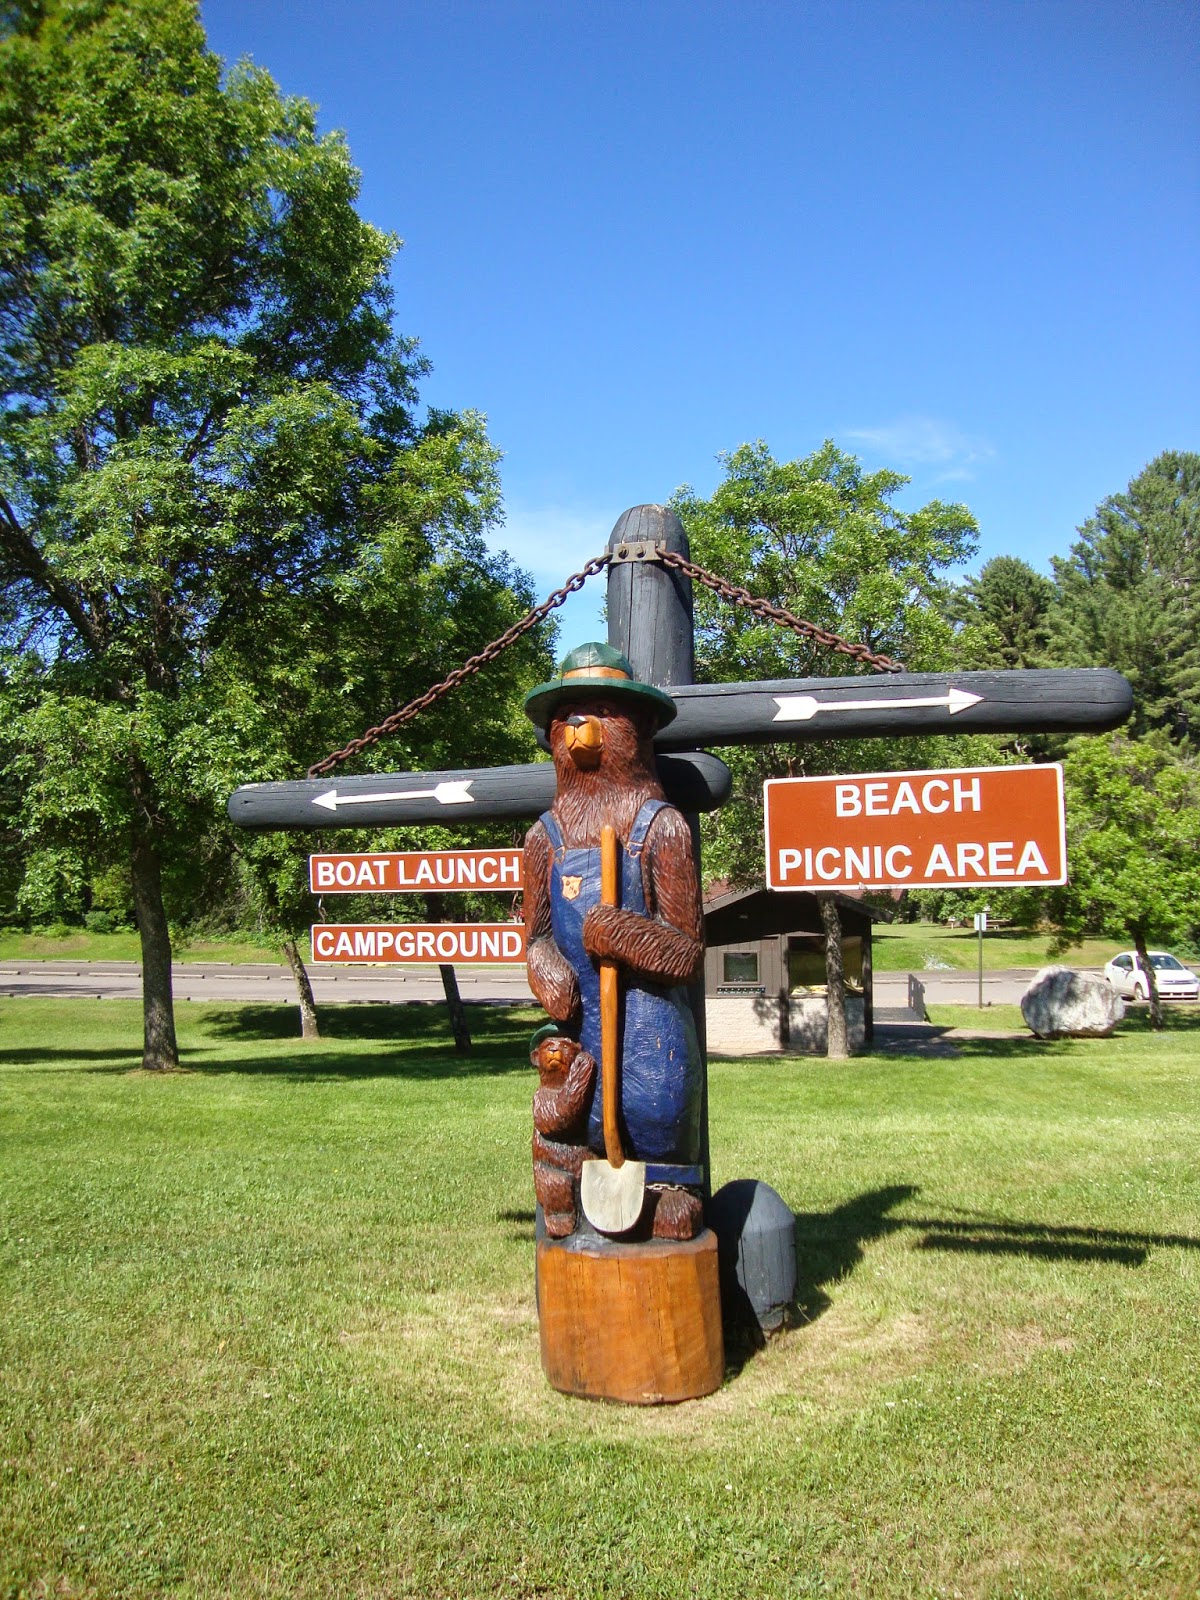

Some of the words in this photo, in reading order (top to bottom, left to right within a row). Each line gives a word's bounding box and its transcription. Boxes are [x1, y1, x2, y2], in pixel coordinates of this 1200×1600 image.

[835, 778, 981, 817] BEACH
[317, 861, 390, 886] BOAT
[398, 856, 520, 885] LAUNCH
[779, 845, 913, 881] PICNIC
[924, 840, 1049, 878] AREA
[316, 931, 523, 957] CAMPGROUND
